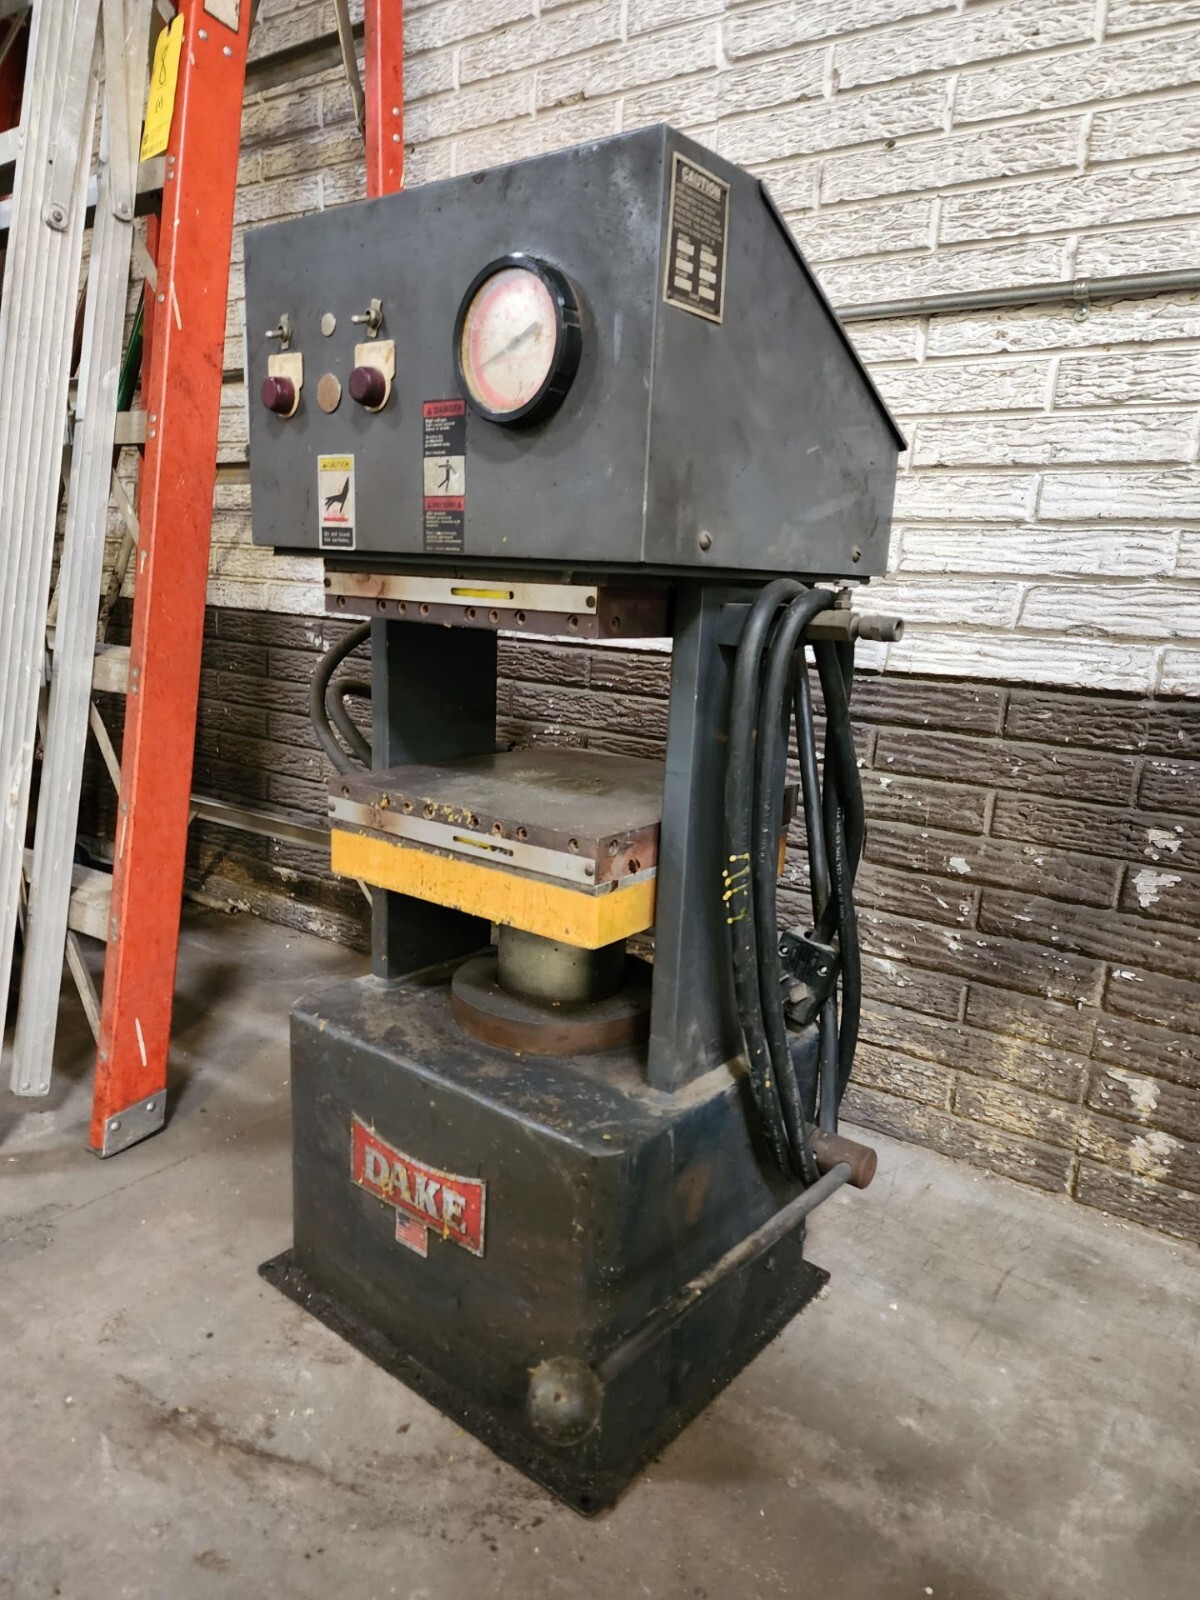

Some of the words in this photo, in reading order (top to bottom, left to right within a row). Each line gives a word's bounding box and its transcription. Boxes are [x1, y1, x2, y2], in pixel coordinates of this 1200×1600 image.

[681, 166, 721, 202] CAUTION
[433, 402, 463, 415] DANGER
[364, 1145, 467, 1234] DAKE
